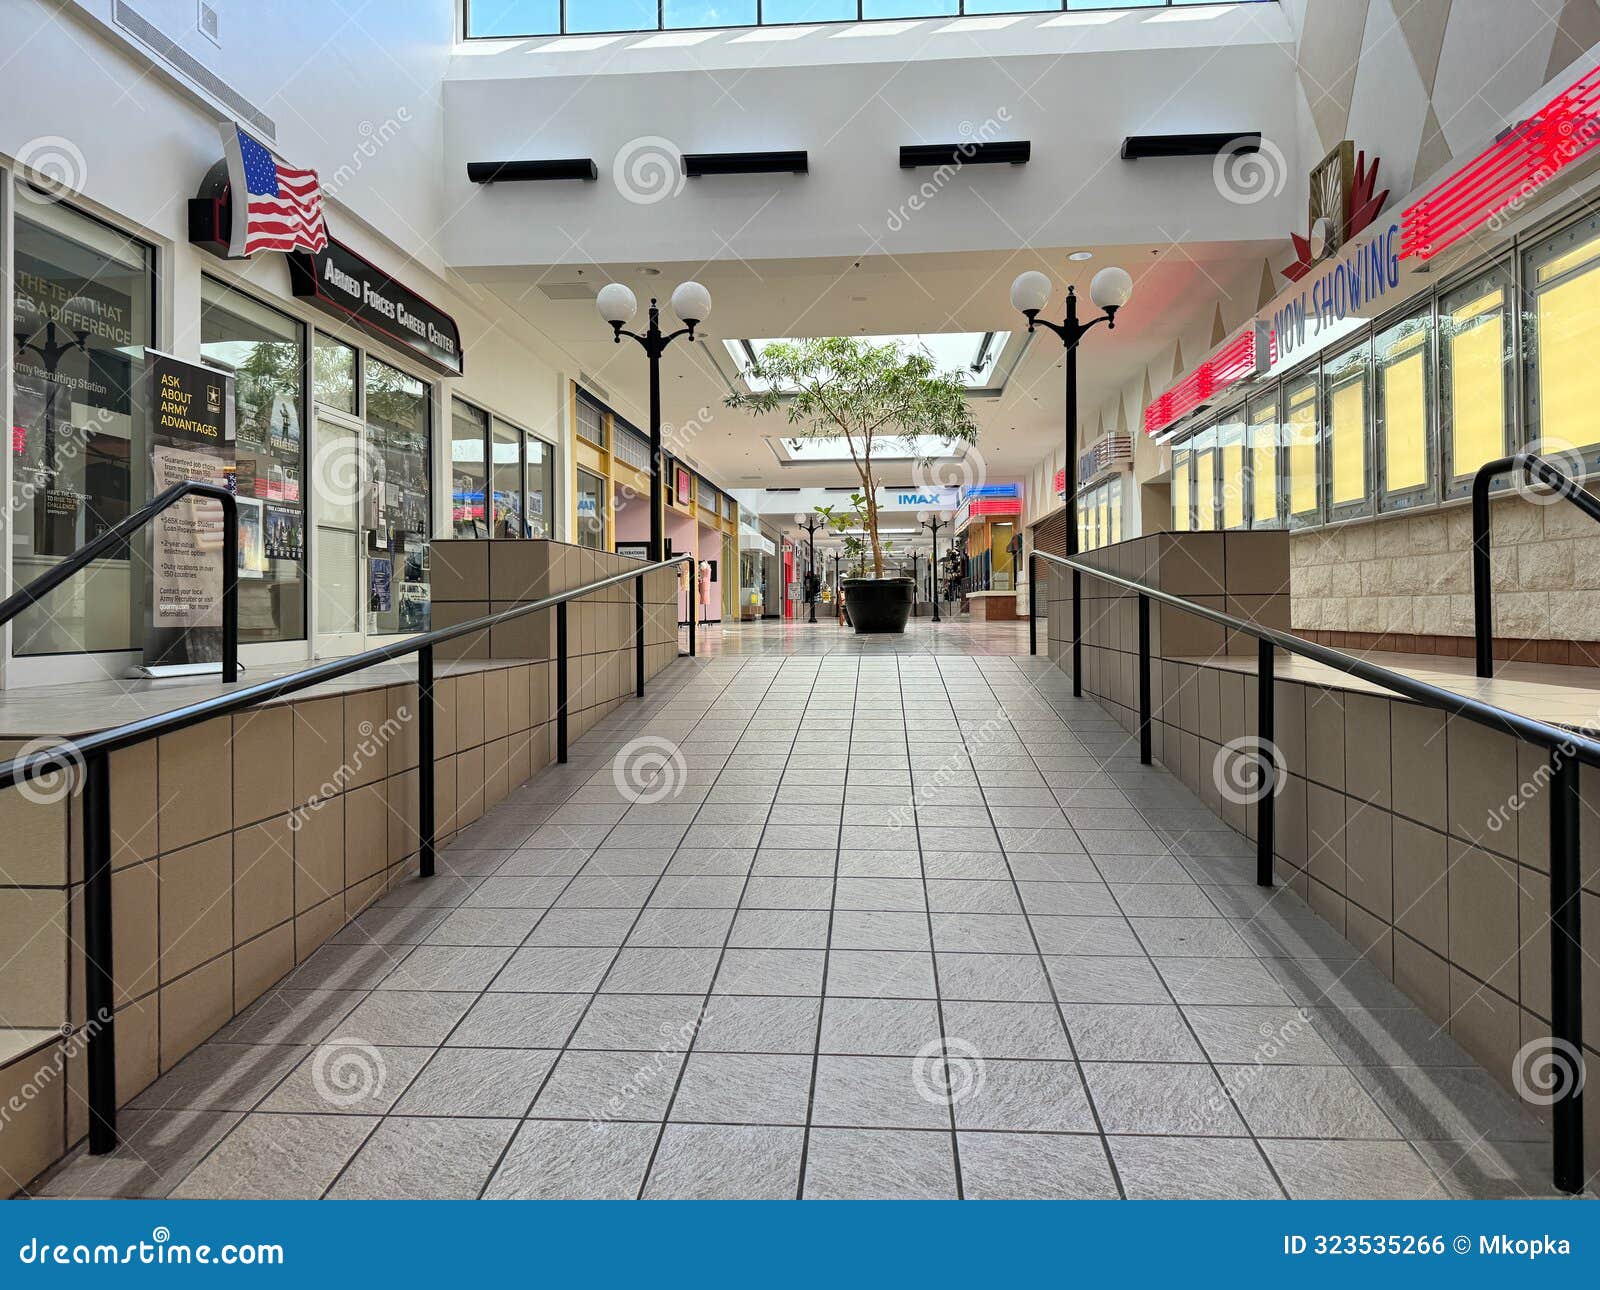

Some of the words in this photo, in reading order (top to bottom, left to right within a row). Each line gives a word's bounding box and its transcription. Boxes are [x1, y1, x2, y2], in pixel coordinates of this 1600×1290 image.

[19, 270, 48, 298] THE
[86, 296, 123, 322] THAT
[1274, 291, 1307, 359] NOW
[1312, 224, 1399, 337] SHOWING
[14, 289, 37, 313] ES
[37, 301, 49, 318] A
[50, 303, 131, 345] DIFFERENCE
[324, 257, 361, 298] ARMED
[363, 280, 396, 319] FORCES
[396, 302, 427, 338] CAREER
[427, 321, 454, 354] CENTER
[34, 366, 78, 389] Recruiting
[78, 378, 108, 395] Station
[161, 373, 181, 388] ASK
[161, 387, 193, 404] ABOUT
[161, 401, 188, 416] ARMY
[161, 414, 218, 437] ADVANTAGES
[898, 494, 940, 504] IMAX
